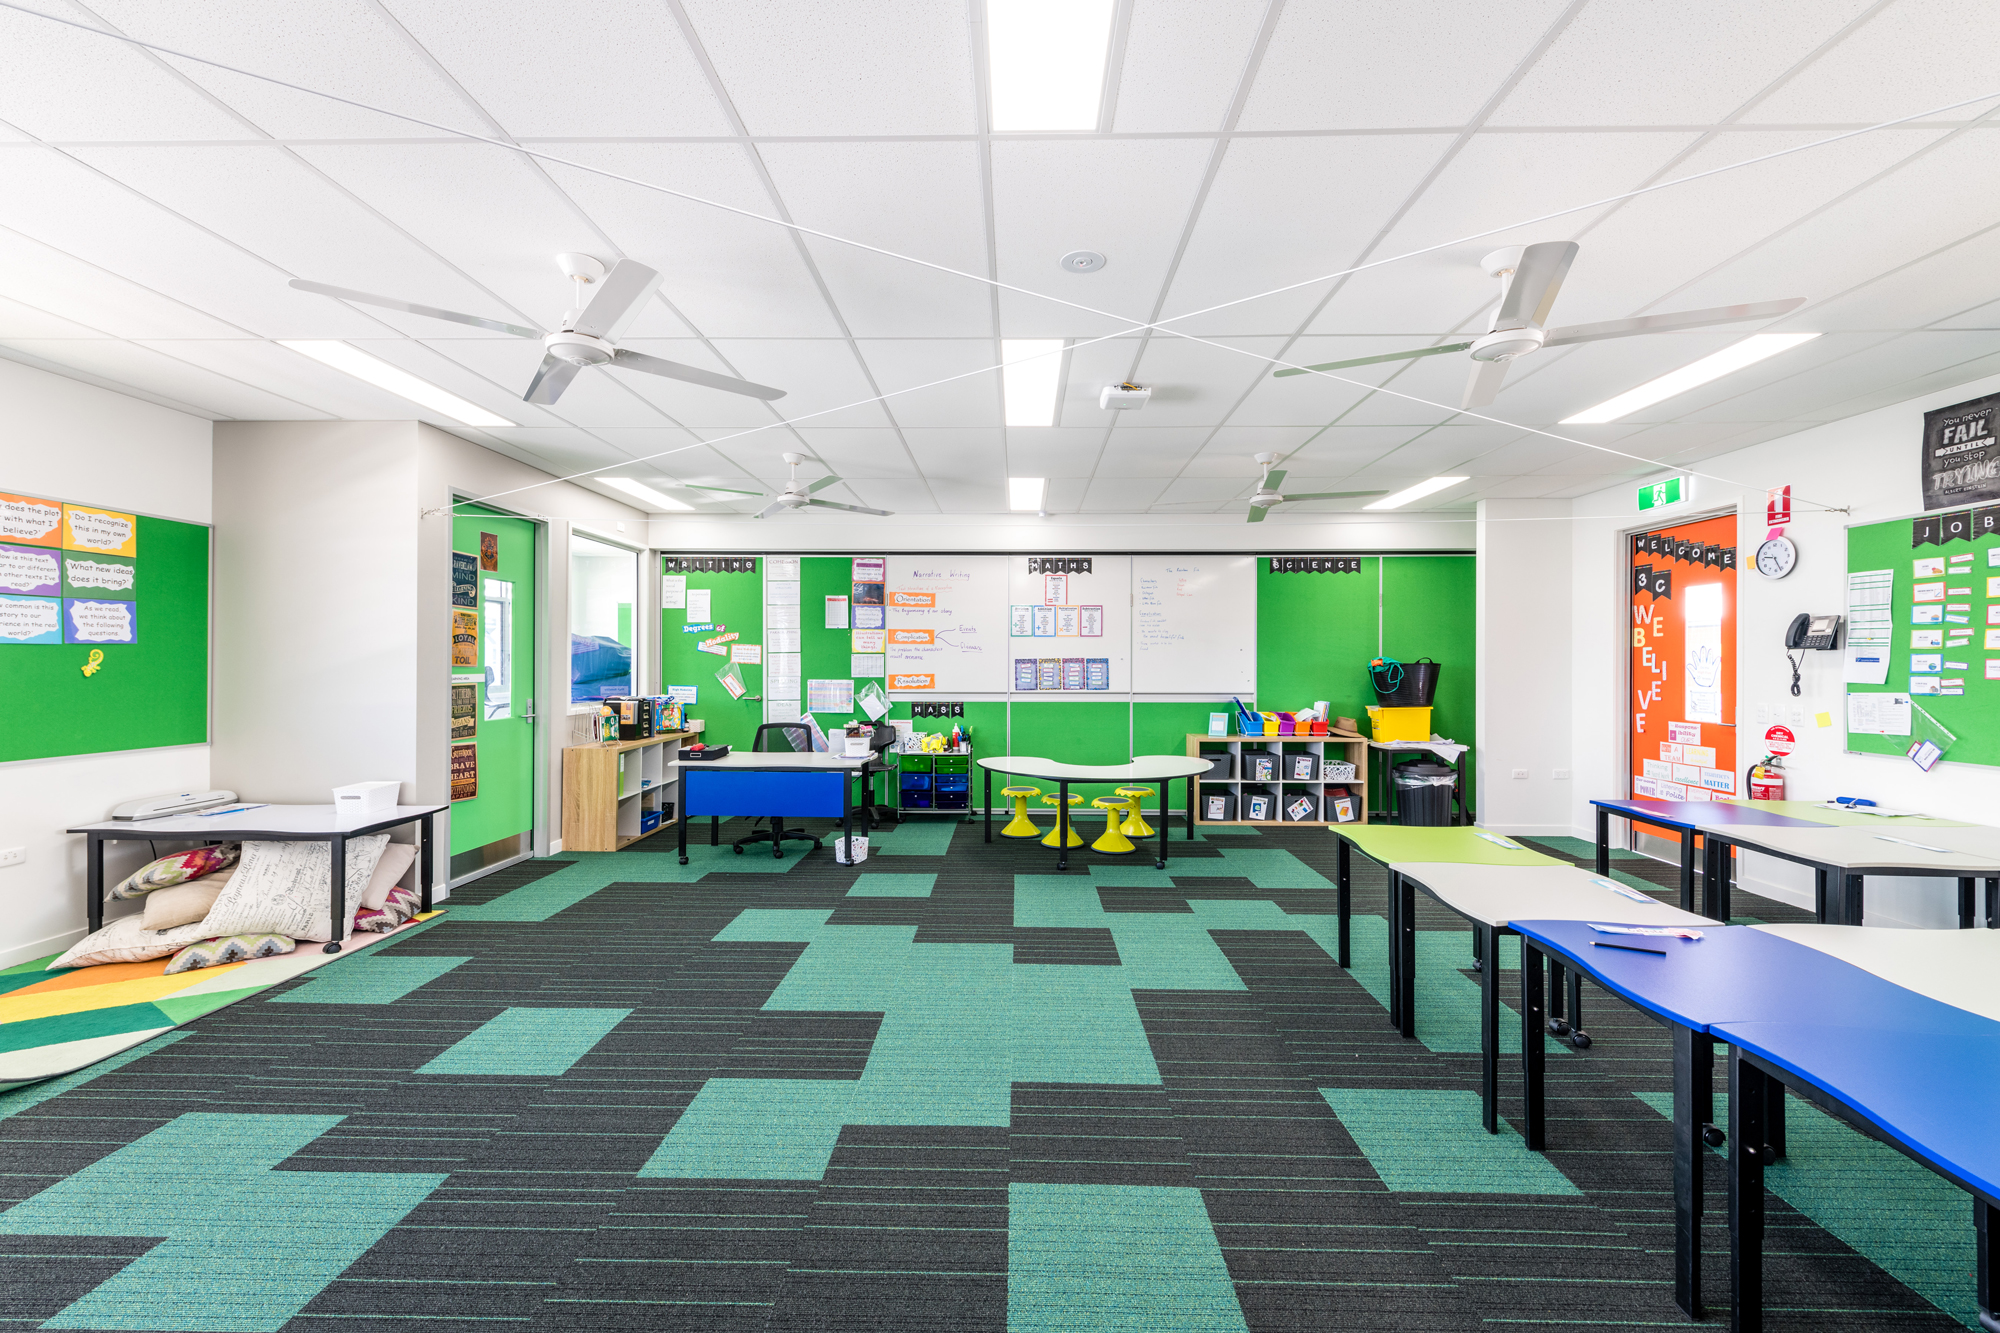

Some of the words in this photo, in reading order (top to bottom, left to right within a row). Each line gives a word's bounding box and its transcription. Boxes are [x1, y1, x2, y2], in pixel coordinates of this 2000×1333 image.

[1962, 408, 1992, 422] never
[1942, 418, 1988, 445] FAIL
[1950, 442, 1980, 452] UNTIL
[1944, 456, 1960, 468] you
[1963, 450, 1986, 462] stop
[1932, 456, 2000, 490] TRYING
[1944, 486, 1962, 495] ALBERT
[1964, 483, 1987, 492] EINSTEIN
[5, 504, 25, 512] does
[94, 517, 129, 528] recognize
[1637, 539, 1732, 564] WELCOME
[114, 567, 134, 576] ideas
[913, 570, 942, 578] Narrative
[950, 570, 970, 581] Writing
[71, 575, 90, 583] does
[452, 572, 475, 581] MIND
[896, 595, 930, 603] Orientation
[683, 624, 713, 633] Degrees
[455, 634, 475, 643] LOYAL
[705, 632, 739, 647] Modality
[896, 632, 928, 641] Complication
[960, 642, 982, 651] Climax
[1686, 748, 1709, 757] LEARNING
[1647, 762, 1668, 771] Thinking
[1704, 771, 1730, 780] manners
[1660, 783, 1682, 793] Listening
[1704, 779, 1730, 789] MATTER
[1640, 785, 1656, 796] POWER
[1666, 791, 1685, 800] Polite
